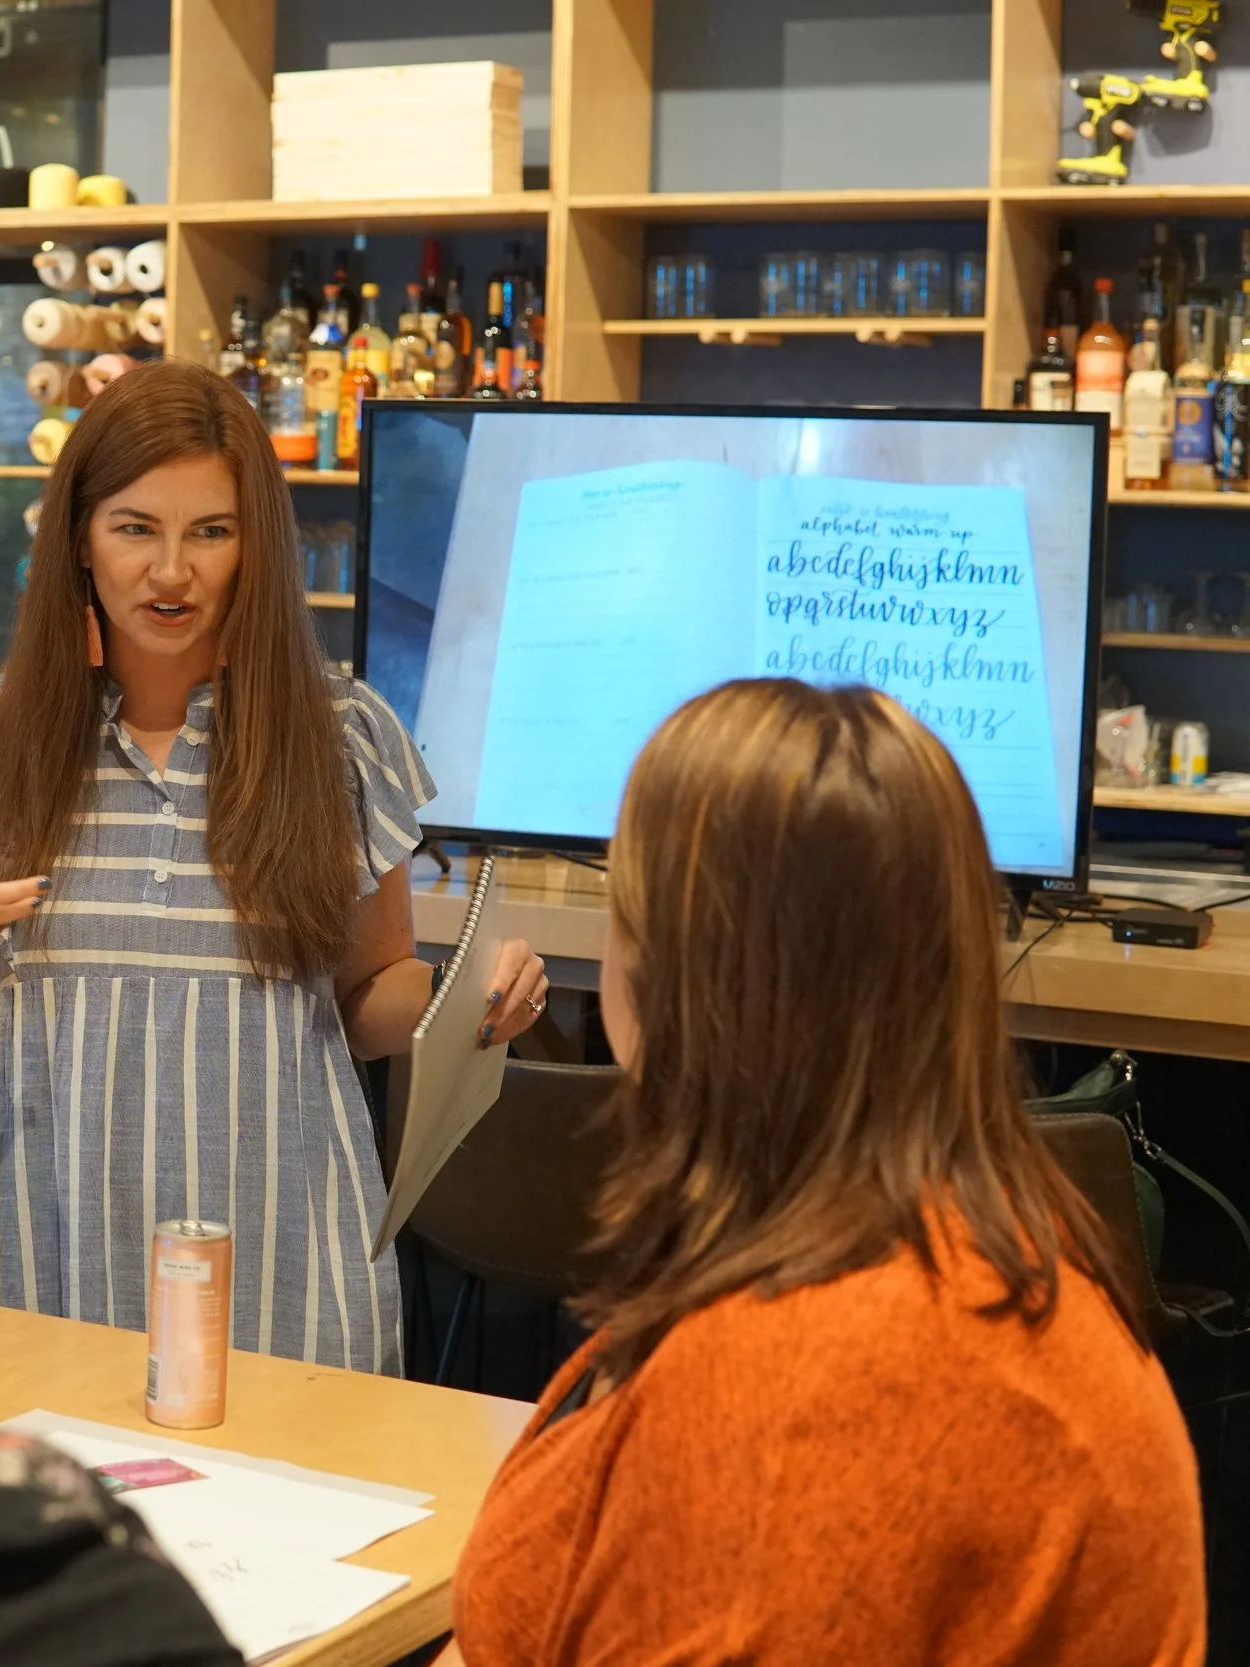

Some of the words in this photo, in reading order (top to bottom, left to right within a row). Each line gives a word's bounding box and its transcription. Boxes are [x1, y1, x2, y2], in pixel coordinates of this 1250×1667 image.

[801, 517, 880, 539] alphabet
[891, 524, 941, 539] warm
[950, 529, 973, 545] up
